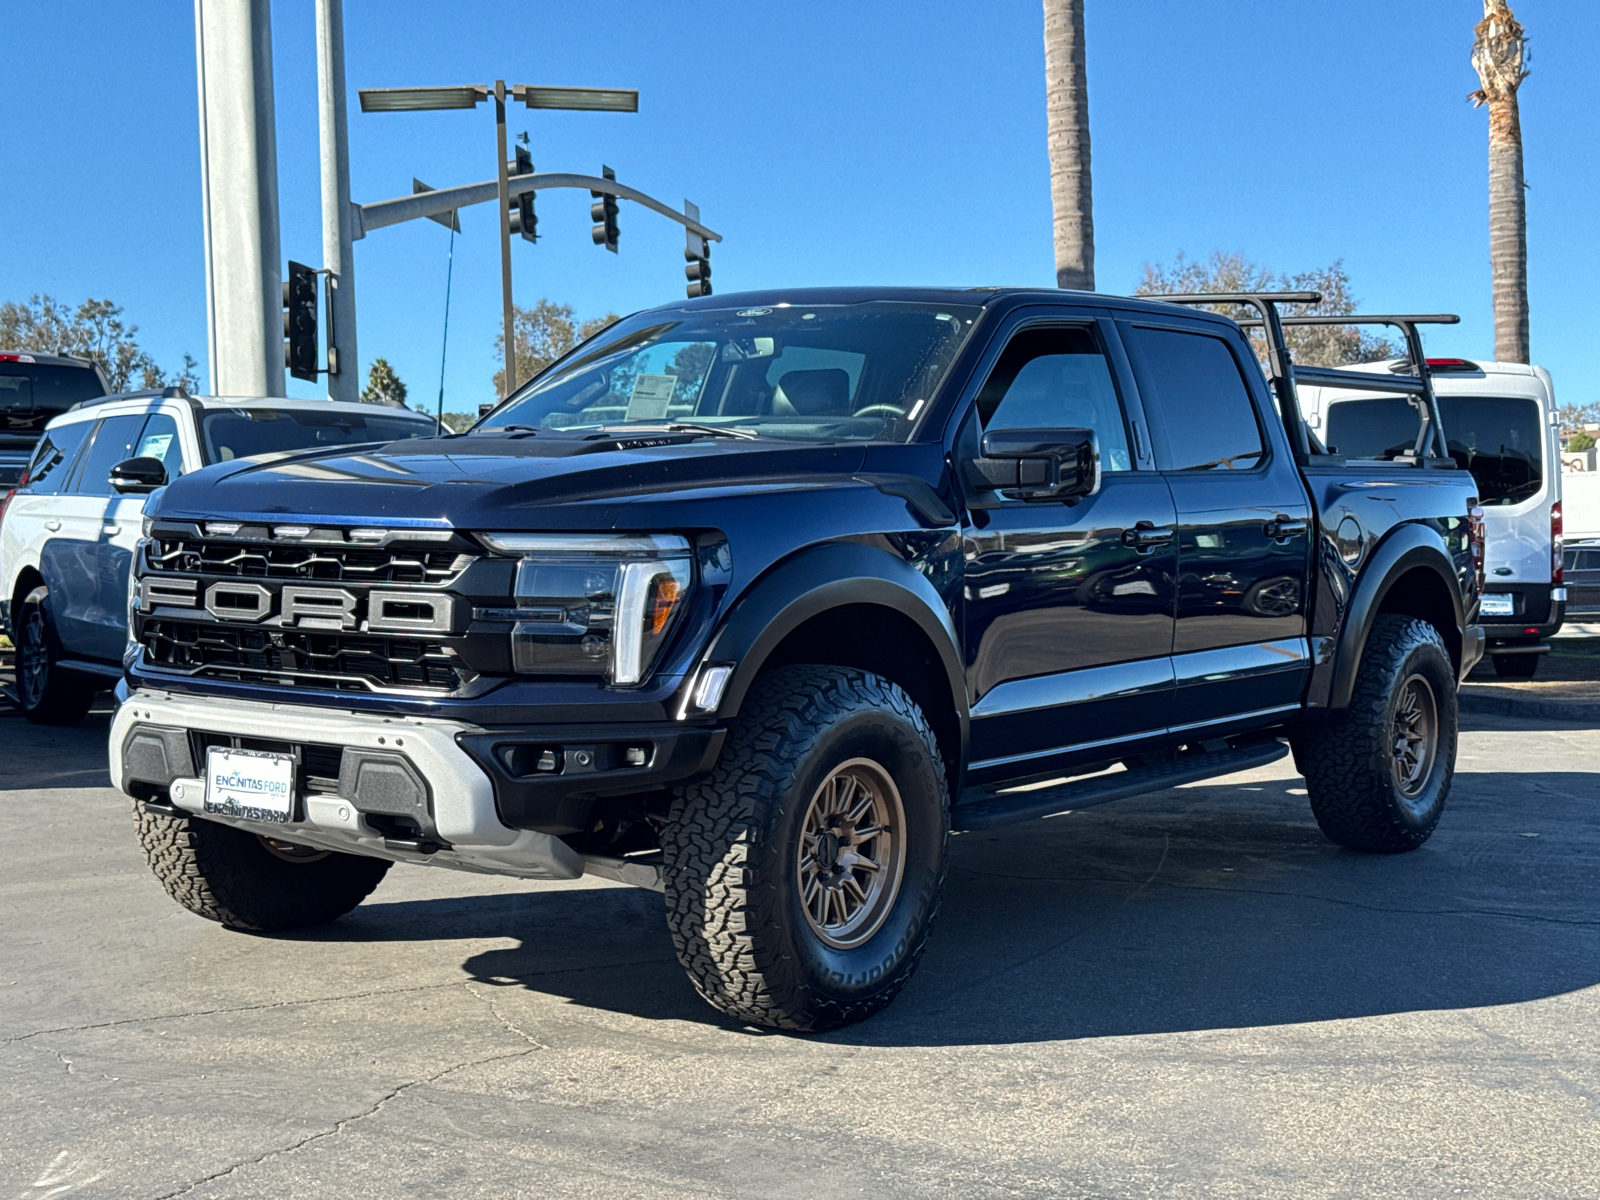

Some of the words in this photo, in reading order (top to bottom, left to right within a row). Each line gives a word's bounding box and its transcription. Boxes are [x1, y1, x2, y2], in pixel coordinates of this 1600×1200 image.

[140, 577, 454, 631] FORD
[216, 775, 263, 790] ENCINITAS
[264, 780, 287, 793] FORD
[207, 802, 260, 819] ENCINITAS
